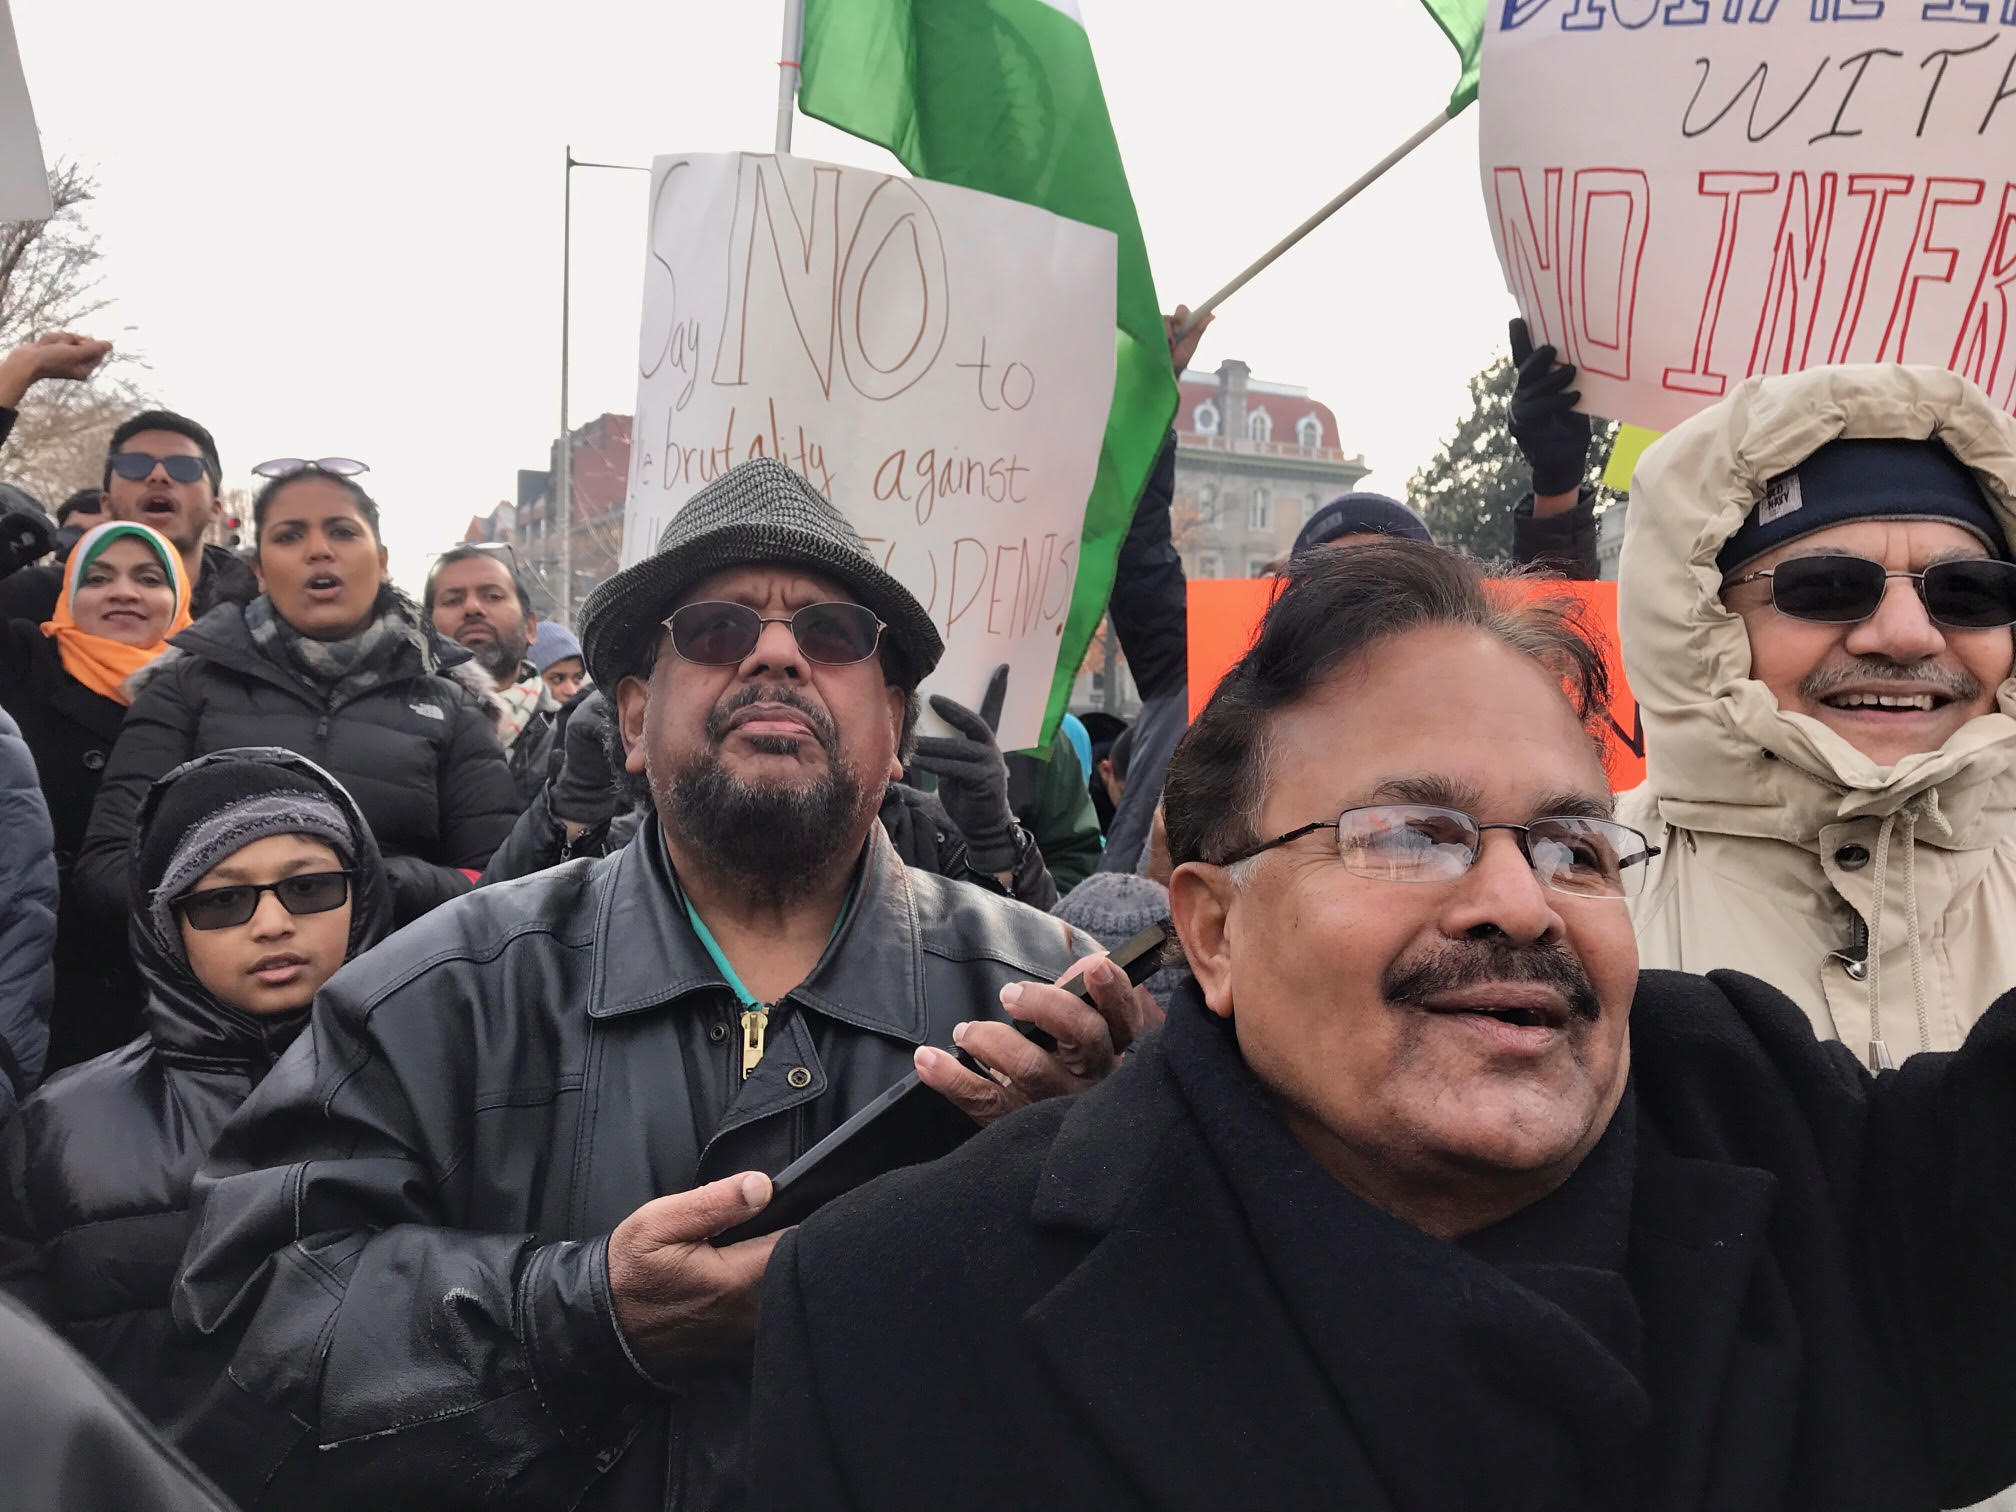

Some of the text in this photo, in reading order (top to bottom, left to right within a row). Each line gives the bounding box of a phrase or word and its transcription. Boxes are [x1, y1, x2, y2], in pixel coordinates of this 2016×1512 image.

[640, 153, 1035, 412] Say NO to
[1494, 167, 2016, 418] NO INTER
[874, 447, 1030, 525] against
